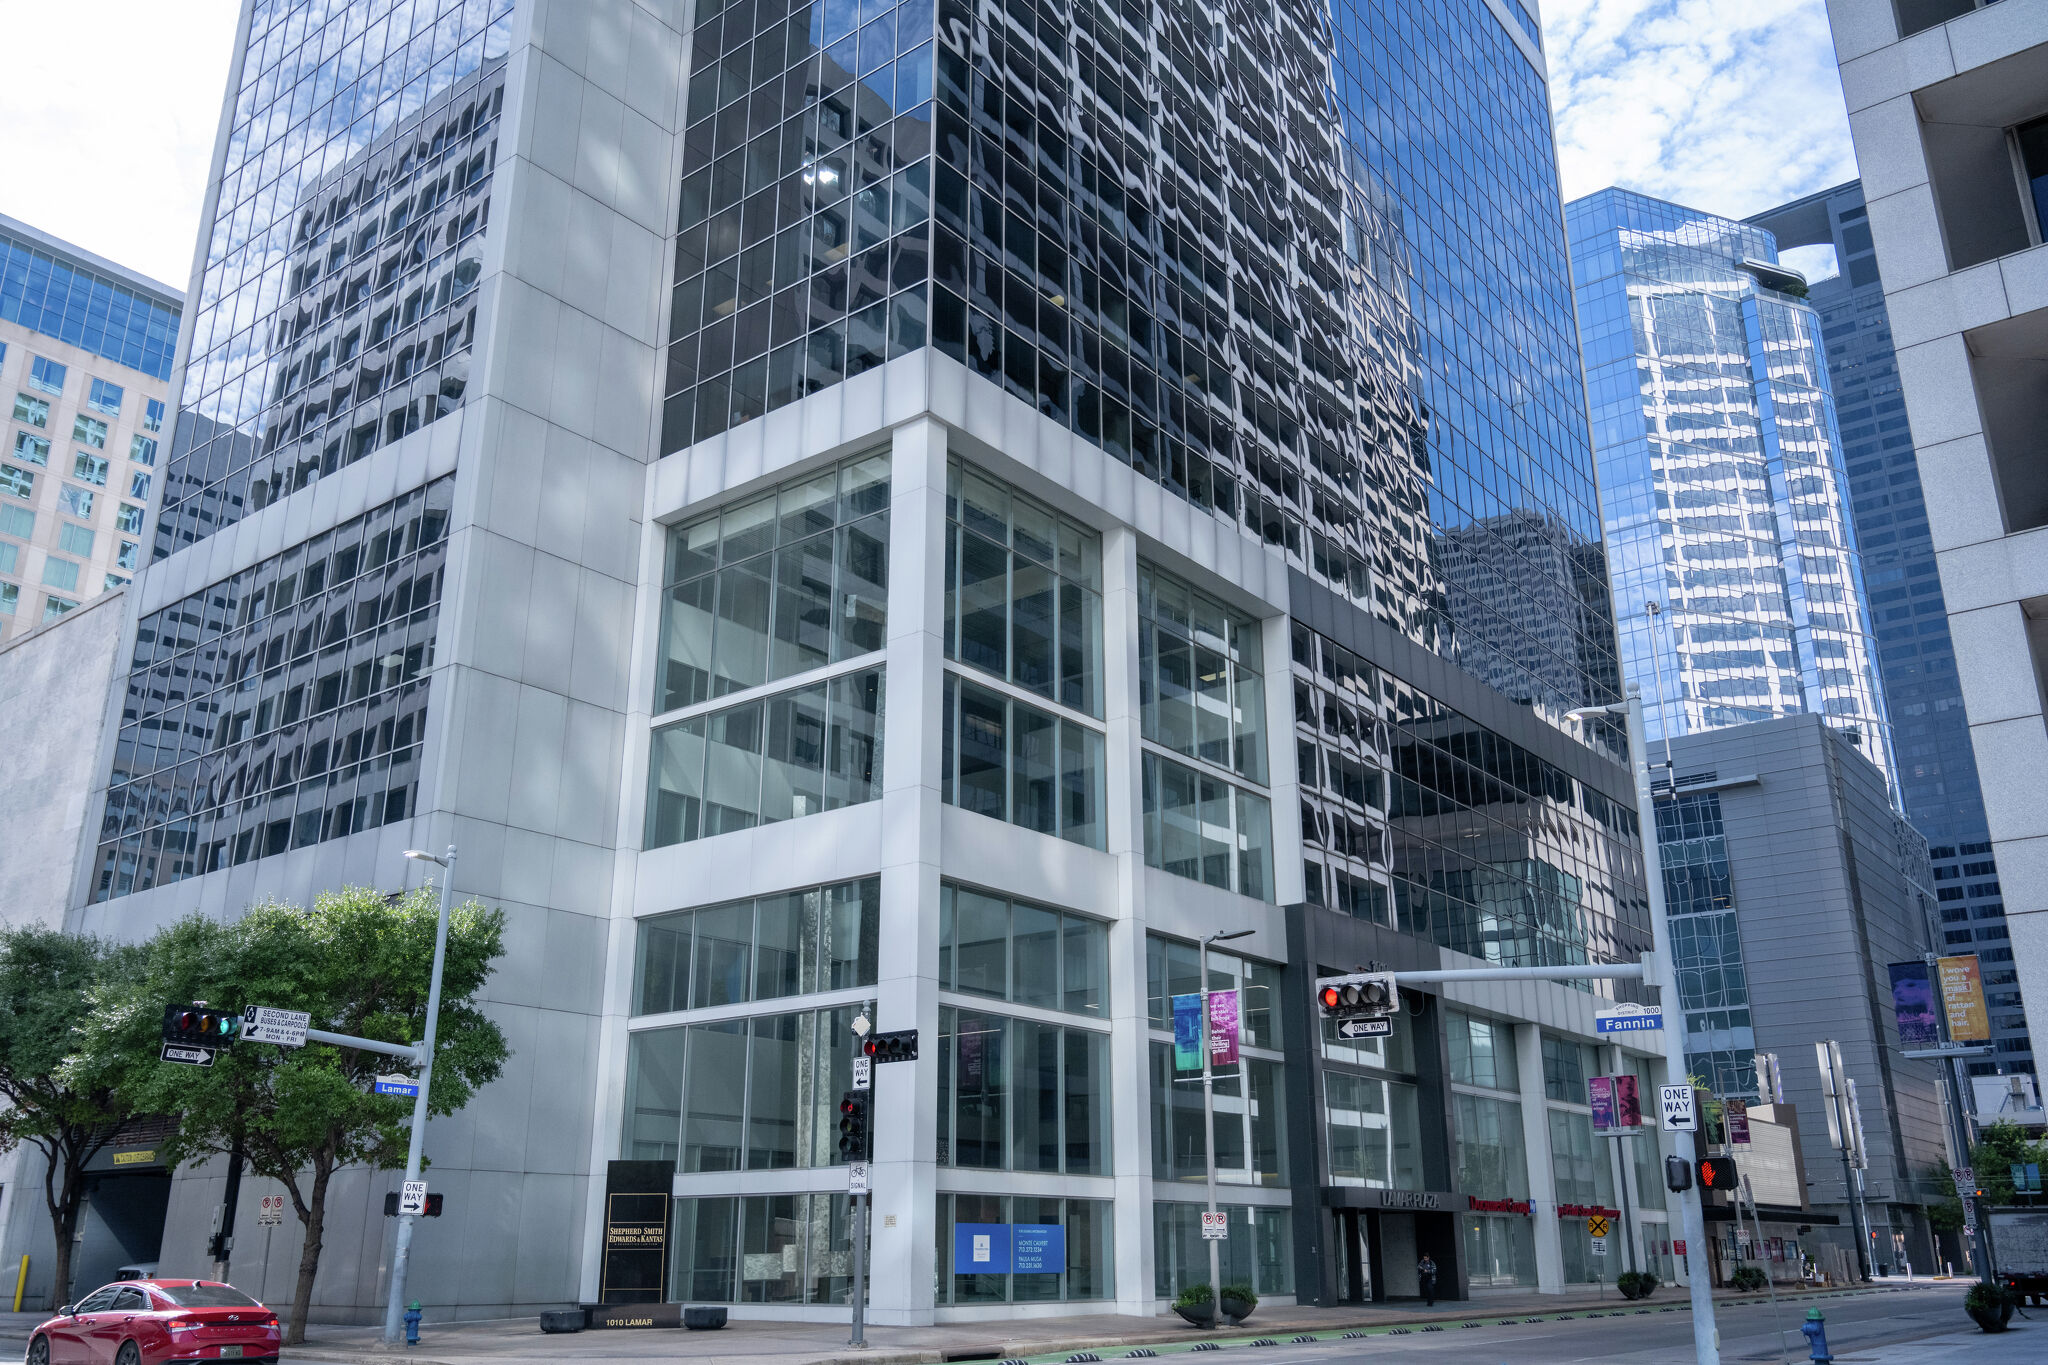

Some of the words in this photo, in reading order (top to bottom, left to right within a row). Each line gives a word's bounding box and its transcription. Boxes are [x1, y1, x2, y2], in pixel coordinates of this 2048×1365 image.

[1946, 993, 1956, 1001] of
[263, 1010, 290, 1019] SECOND
[291, 1013, 306, 1021] LANE
[281, 1021, 306, 1029] CARPOOLS
[1354, 1024, 1368, 1032] ONE
[1606, 1018, 1655, 1030] Fannin
[185, 1051, 199, 1059] WAY
[856, 1060, 868, 1068] ONE
[382, 1084, 412, 1094] Lamar
[1664, 1089, 1688, 1100] ONE
[1664, 1101, 1689, 1112] WAY
[405, 1184, 423, 1192] ONE
